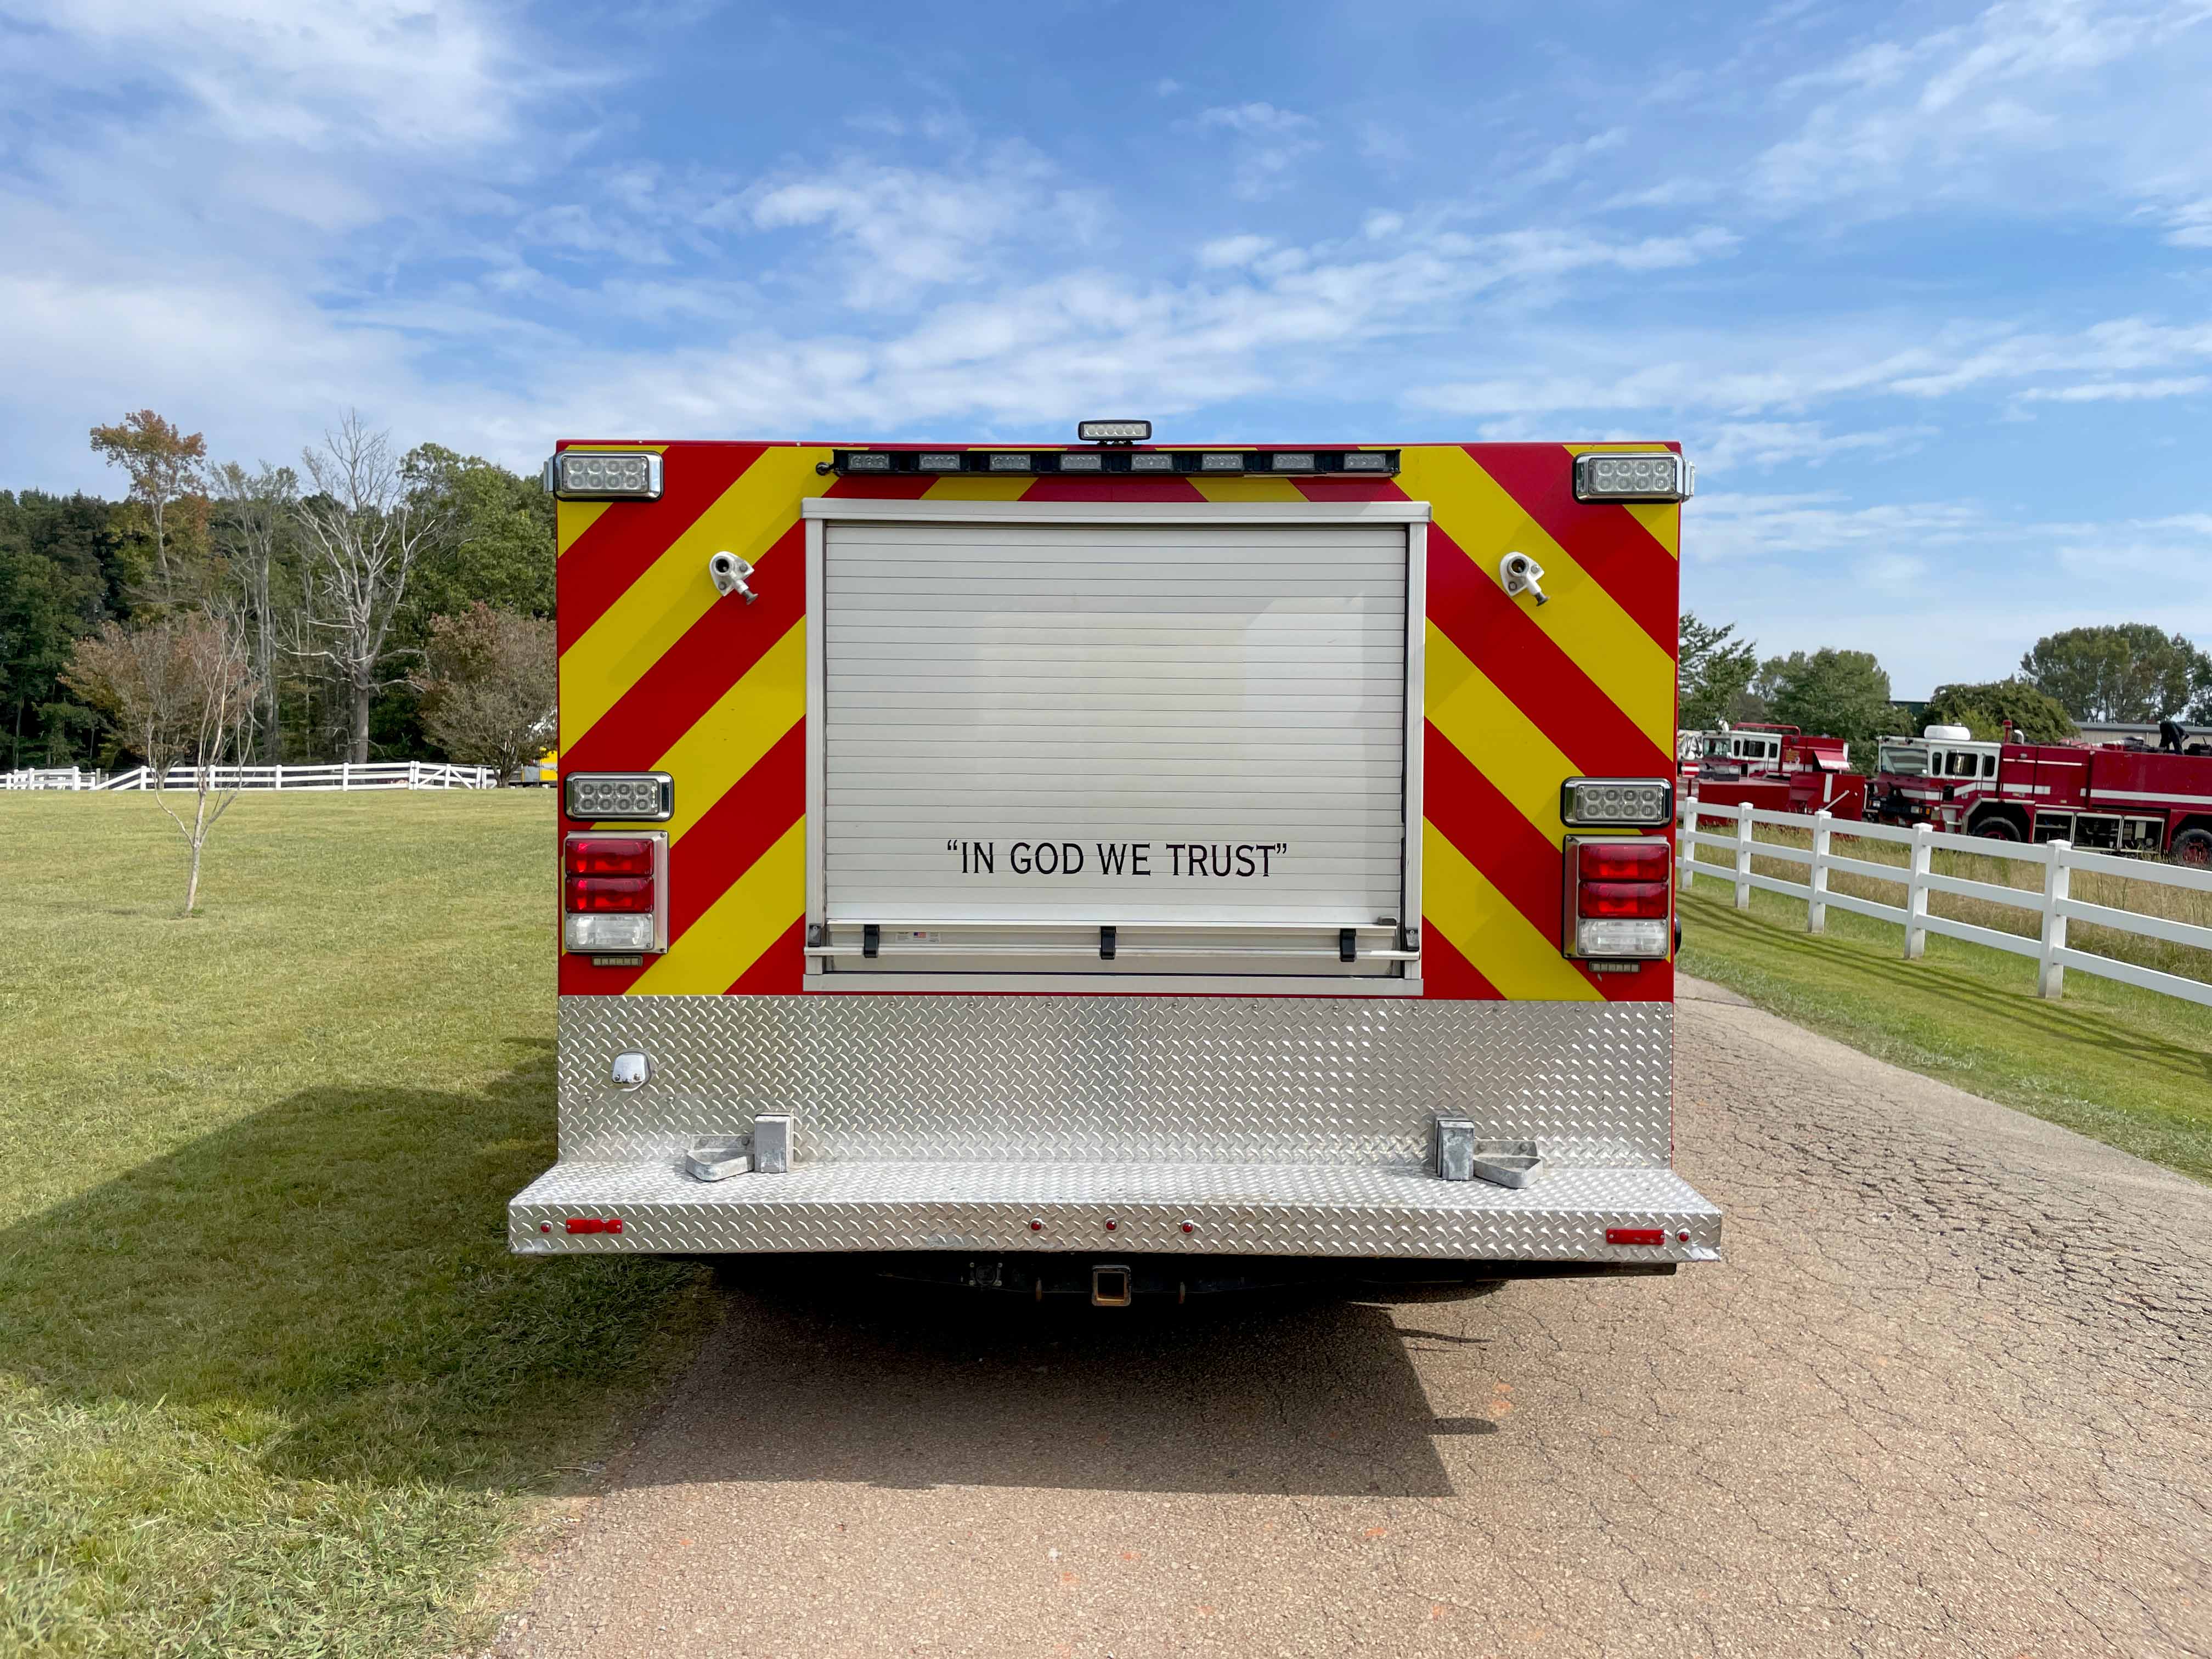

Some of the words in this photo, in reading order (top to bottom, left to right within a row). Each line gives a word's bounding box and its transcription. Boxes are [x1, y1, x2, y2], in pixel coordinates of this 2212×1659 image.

[947, 839, 995, 874] “IN
[1010, 842, 1084, 874] GOD
[1096, 843, 1151, 876] WE
[1166, 843, 1287, 877] TRUST”
